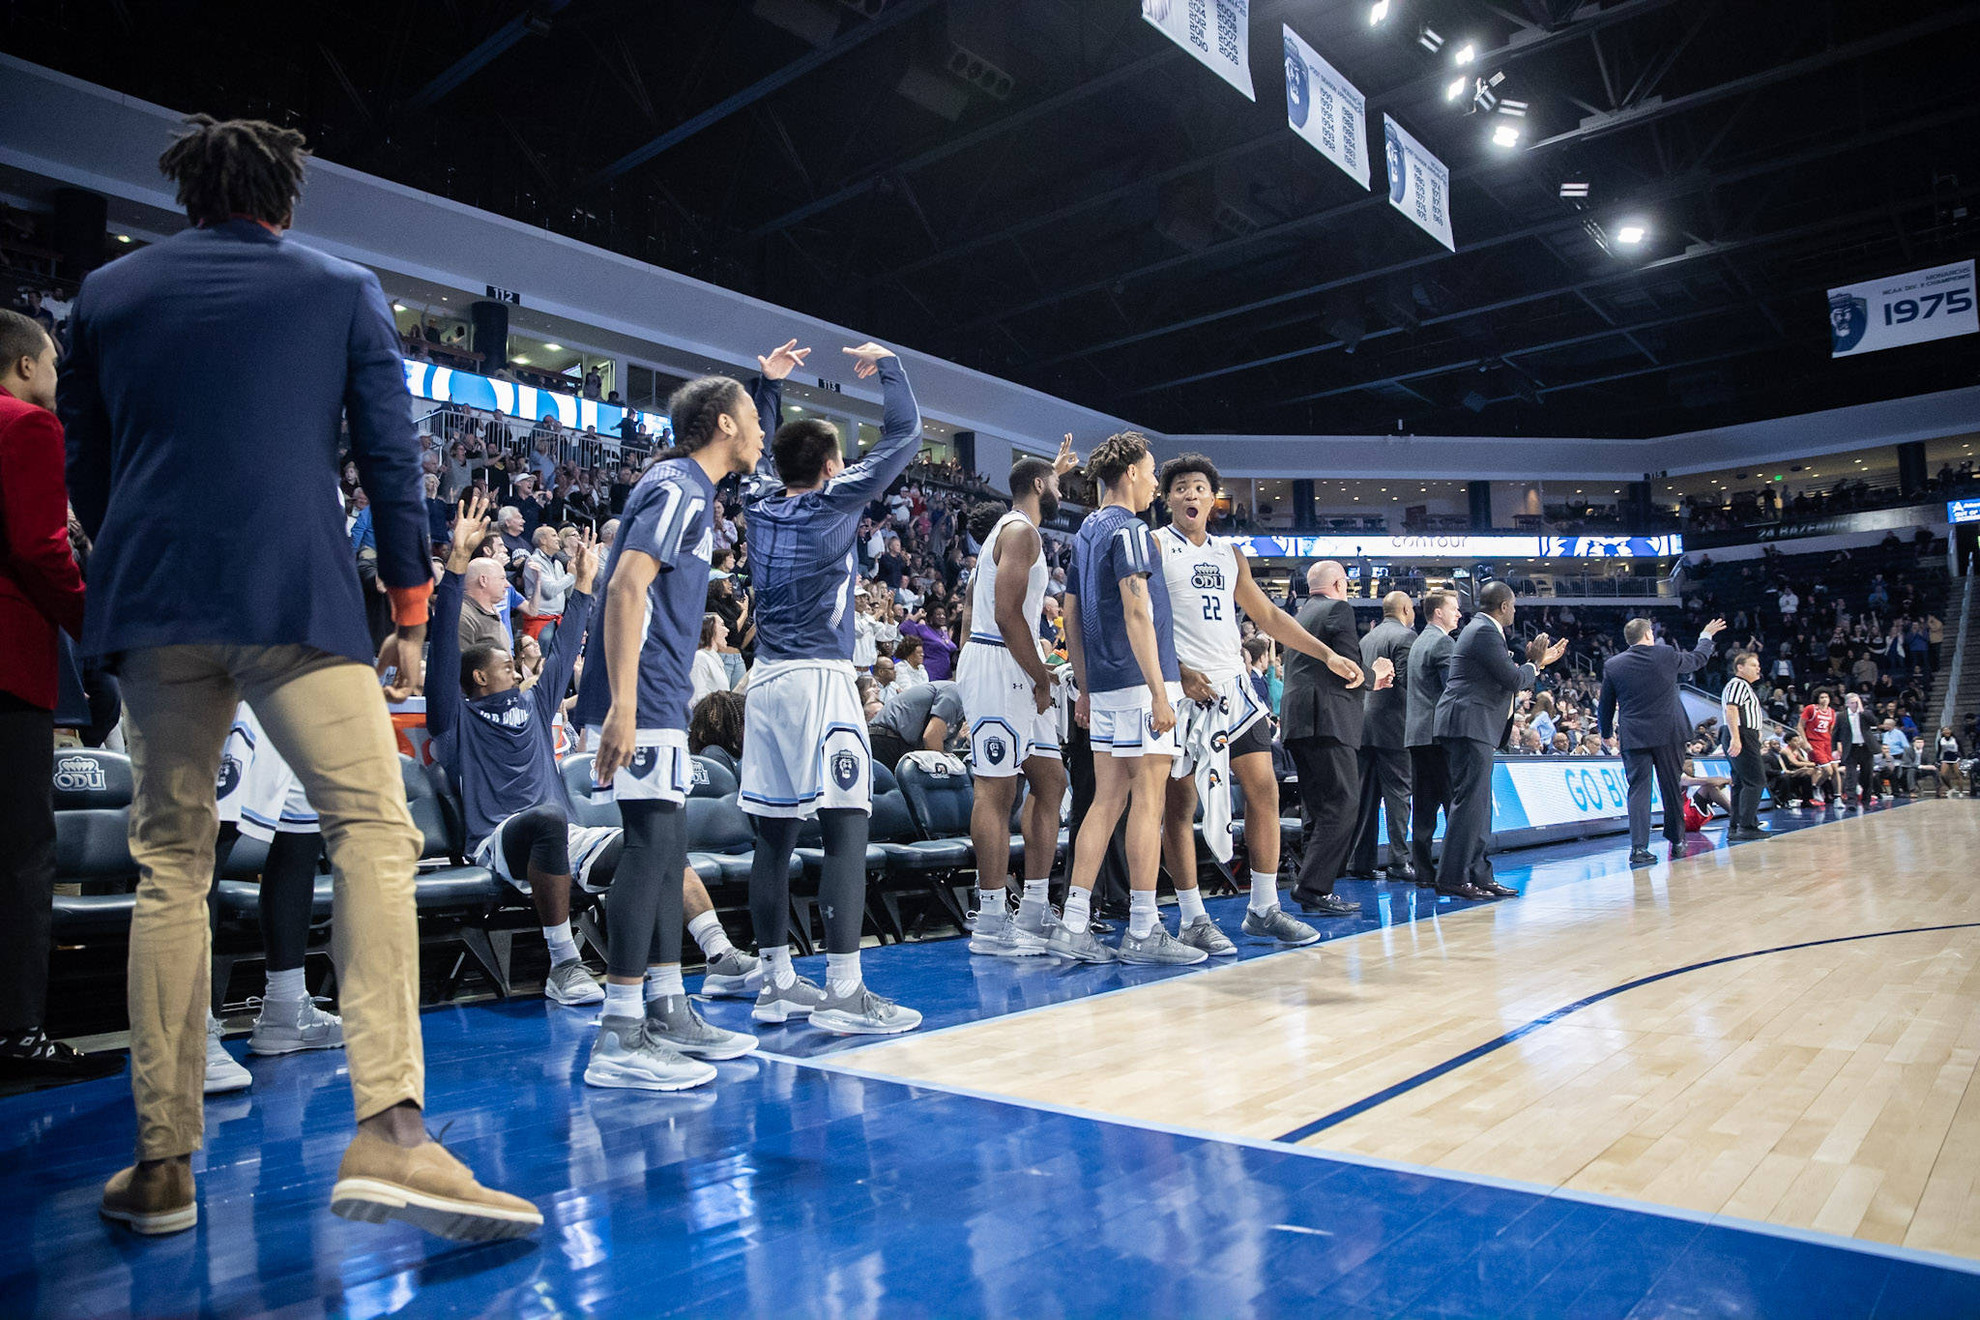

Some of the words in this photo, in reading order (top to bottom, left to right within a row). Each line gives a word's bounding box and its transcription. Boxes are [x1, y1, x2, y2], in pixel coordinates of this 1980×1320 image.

[1188, 9, 1207, 31] 2012
[1189, 20, 1205, 39] 2011
[1217, 21, 1238, 42] 2007
[1190, 32, 1209, 53] 2010
[1218, 32, 1239, 55] 2006
[1218, 43, 1239, 66] 2005
[493, 287, 514, 304] 112
[1884, 287, 1973, 327] 1975
[823, 380, 837, 392] 113
[1191, 574, 1225, 591] ODU
[1201, 595, 1223, 621] 22
[53, 770, 107, 791] ODU
[690, 769, 710, 785] DU
[1564, 768, 1603, 812] GO
